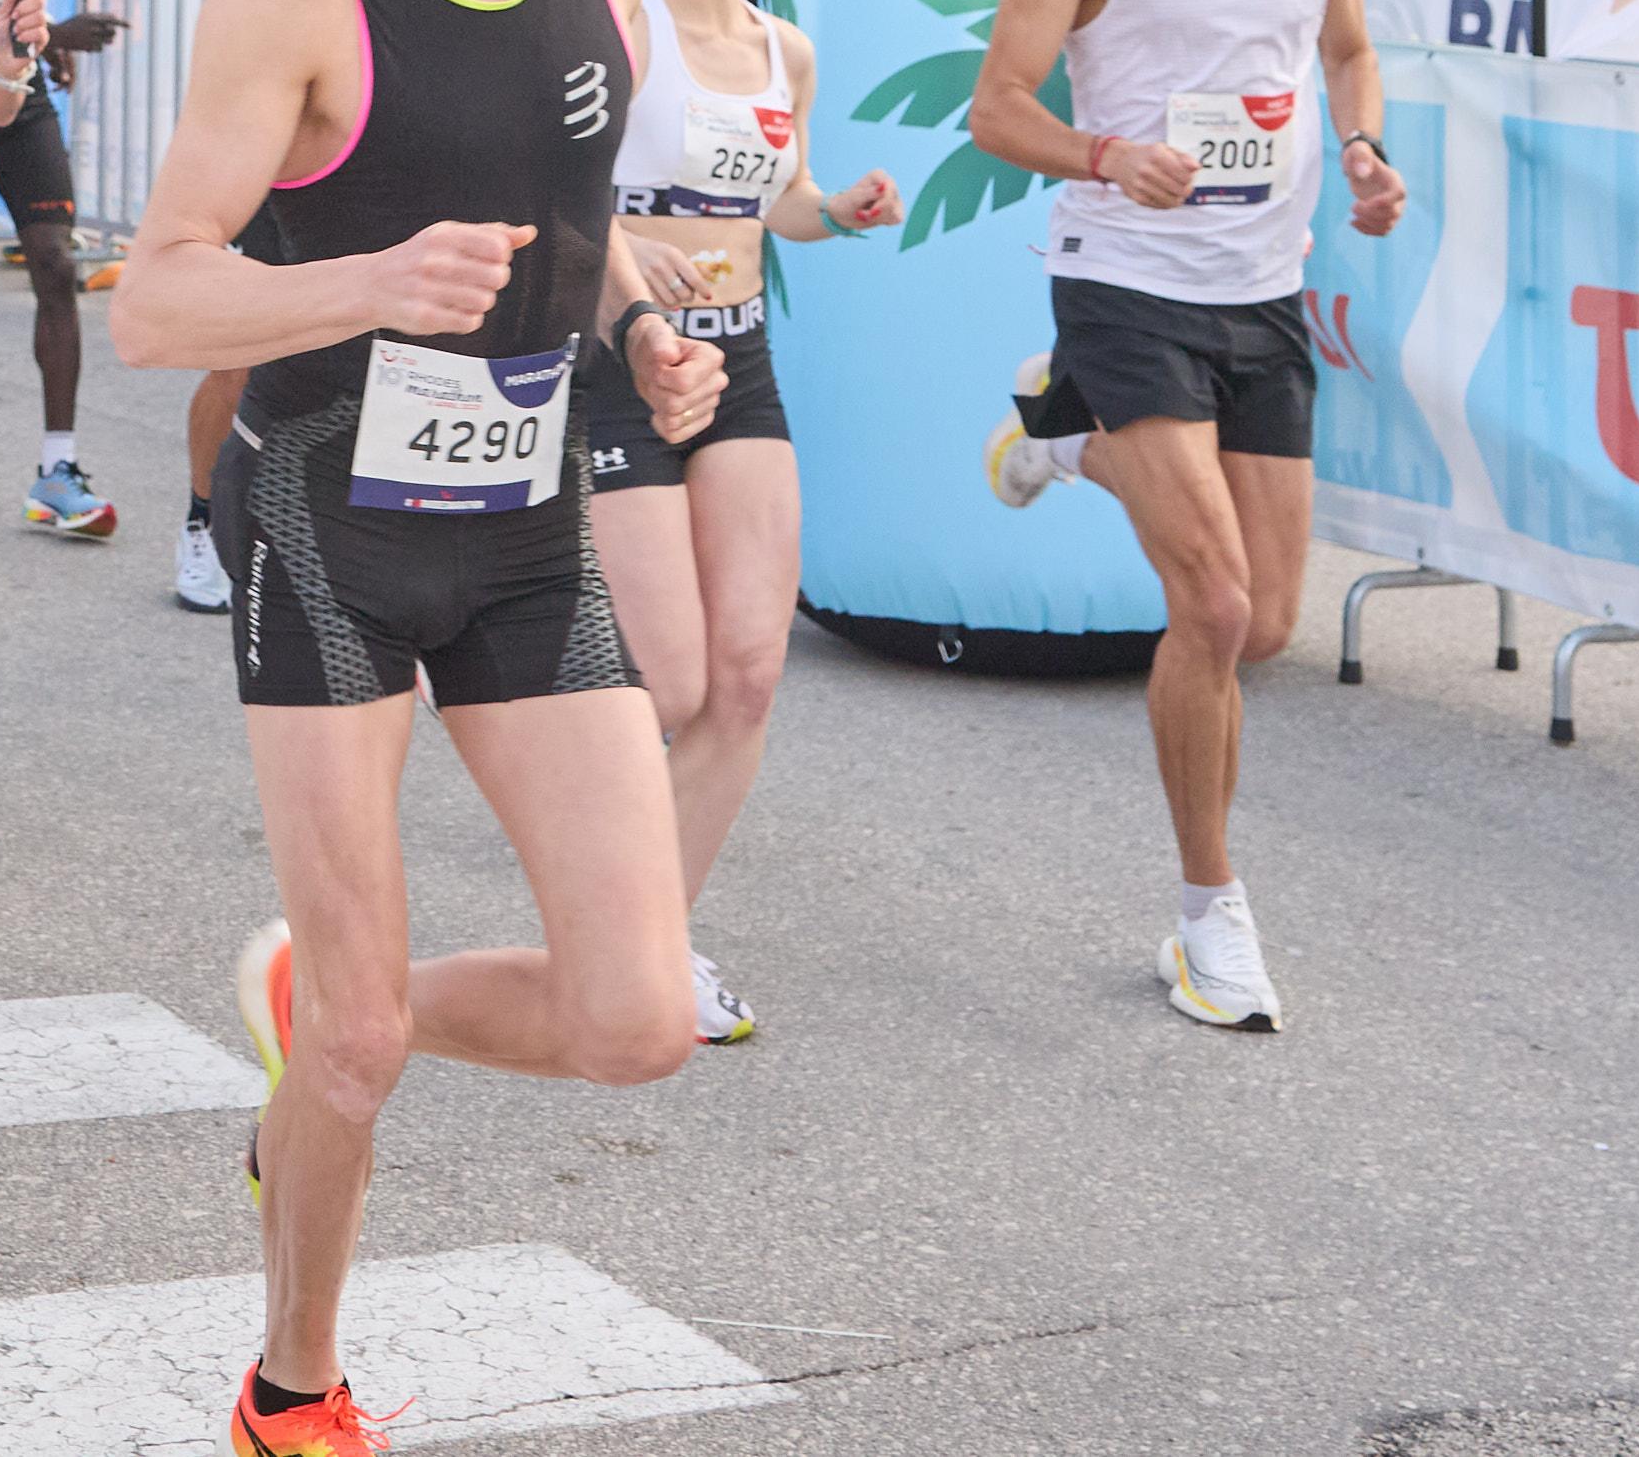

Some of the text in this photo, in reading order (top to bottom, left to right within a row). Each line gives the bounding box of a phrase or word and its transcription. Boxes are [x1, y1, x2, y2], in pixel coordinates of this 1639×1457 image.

[711, 148, 779, 185] 2671
[1200, 138, 1274, 169] 2001
[408, 416, 539, 463] 4290
